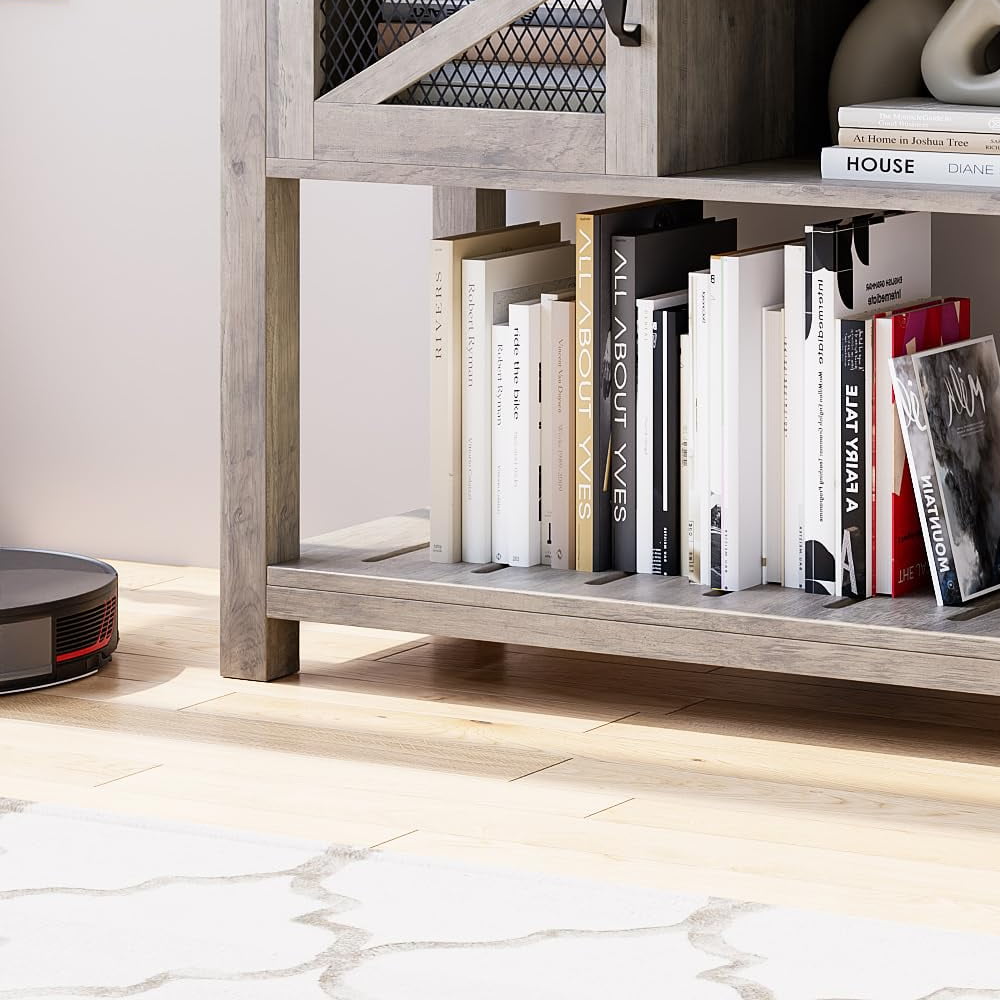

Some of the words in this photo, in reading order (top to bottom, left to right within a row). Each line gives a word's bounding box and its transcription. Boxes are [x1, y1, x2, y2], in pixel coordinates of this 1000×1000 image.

[847, 156, 915, 174] HOUSE
[853, 134, 865, 143] At
[868, 135, 897, 144] Home
[900, 136, 909, 144] in
[911, 136, 944, 147] Joshua
[947, 138, 969, 148] Tree
[948, 163, 994, 176] DIANE
[579, 229, 592, 289] ALL
[614, 249, 628, 306] ALL
[435, 271, 443, 359] RIVERS
[467, 336, 475, 387] Ryman
[578, 302, 592, 419] ABOUT
[614, 316, 628, 429] ABOUT
[578, 435, 592, 520] YVES
[613, 443, 627, 522] YVES
